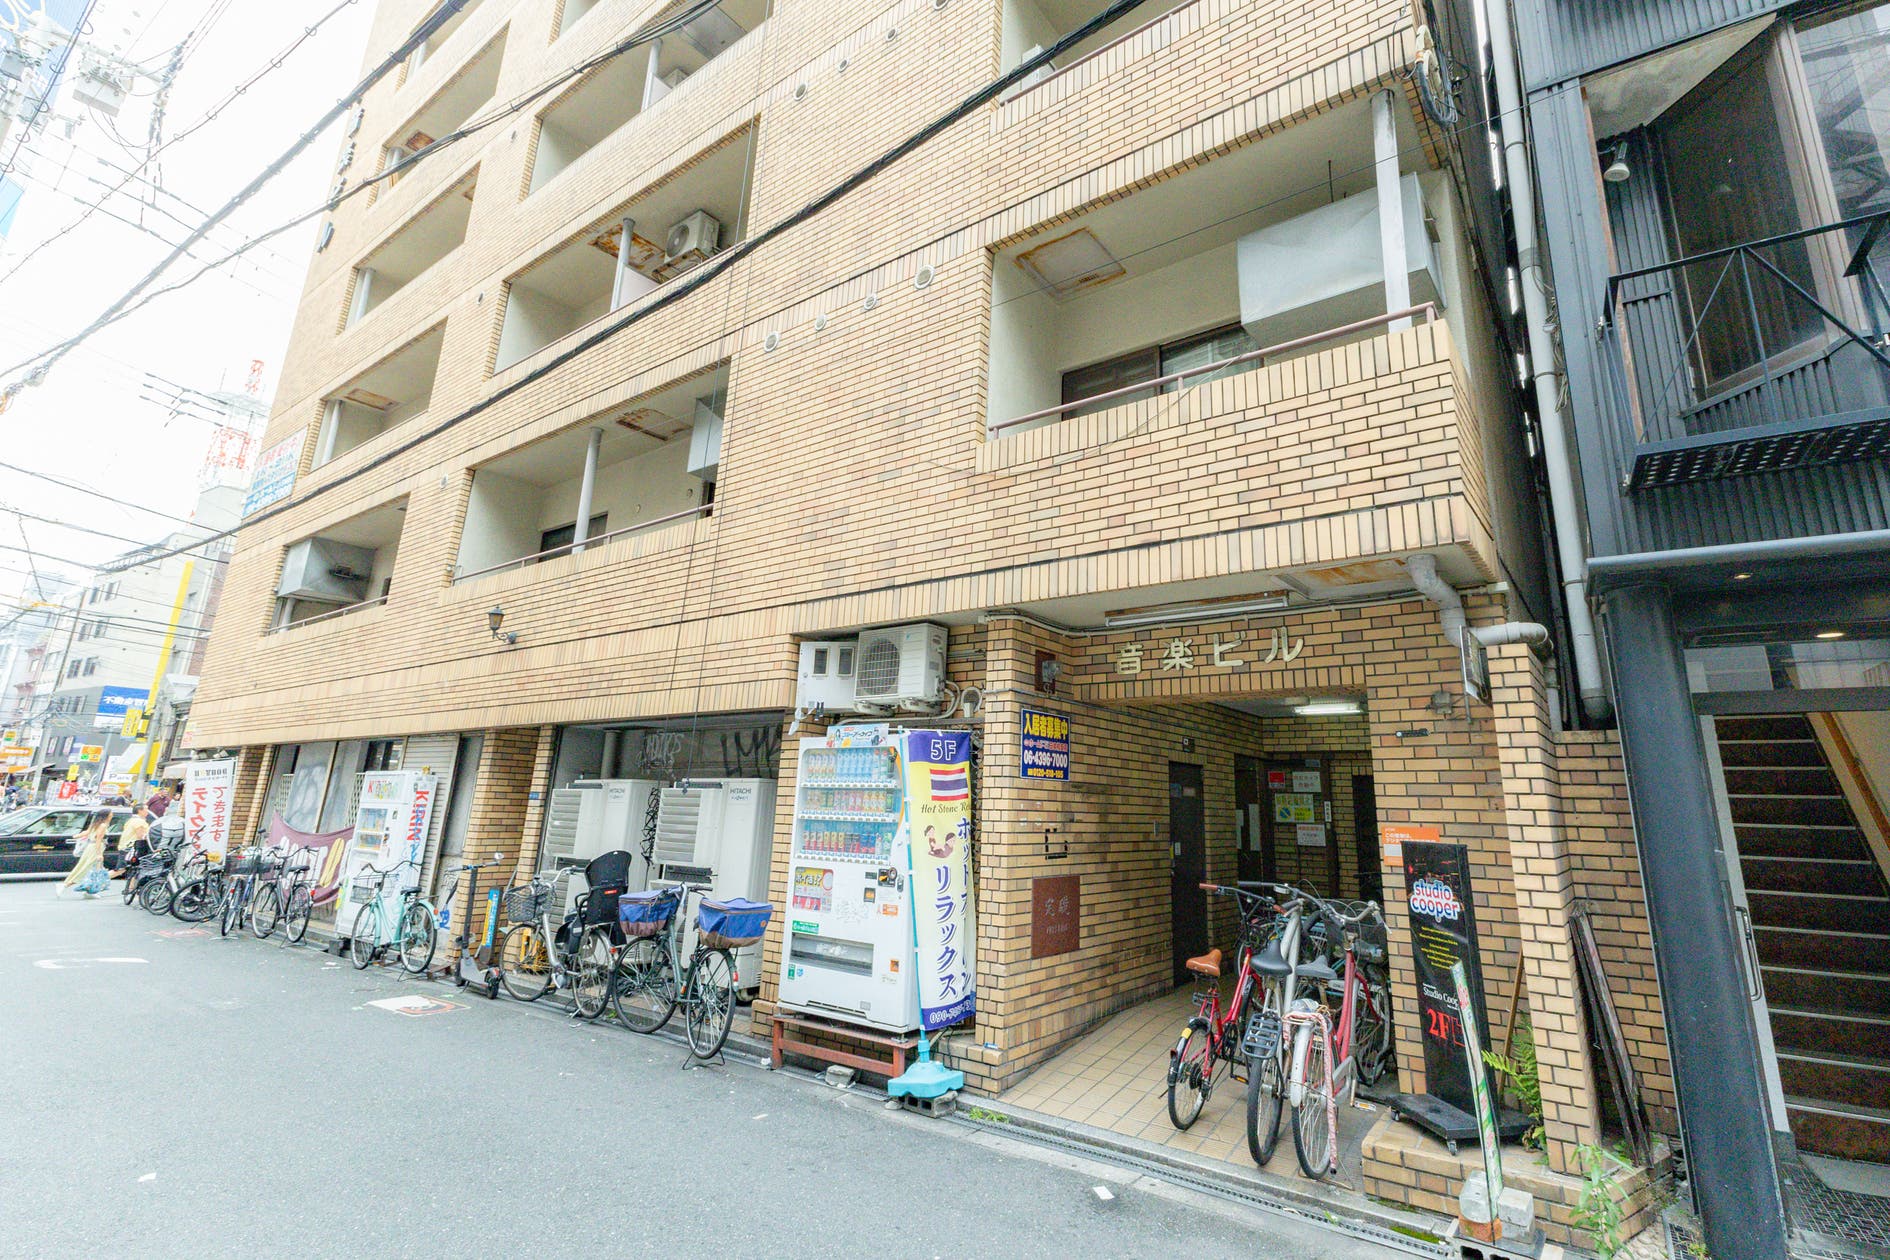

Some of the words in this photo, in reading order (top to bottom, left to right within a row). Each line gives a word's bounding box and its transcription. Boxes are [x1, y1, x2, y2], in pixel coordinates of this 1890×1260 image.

[1117, 626, 1304, 675] 音楽ビル
[1023, 712, 1068, 740] 入居者募集中
[930, 739, 957, 761] 5F
[1023, 749, 1068, 768] 06-4396-7000
[406, 790, 430, 842] KIRIN
[921, 804, 936, 814] Hot
[938, 803, 958, 814] Stone
[1415, 881, 1452, 900] studio
[1412, 897, 1458, 918] cooper
[935, 865, 957, 1000] リラックス
[1423, 987, 1443, 1001] Studio
[1427, 1008, 1451, 1040] 2F
